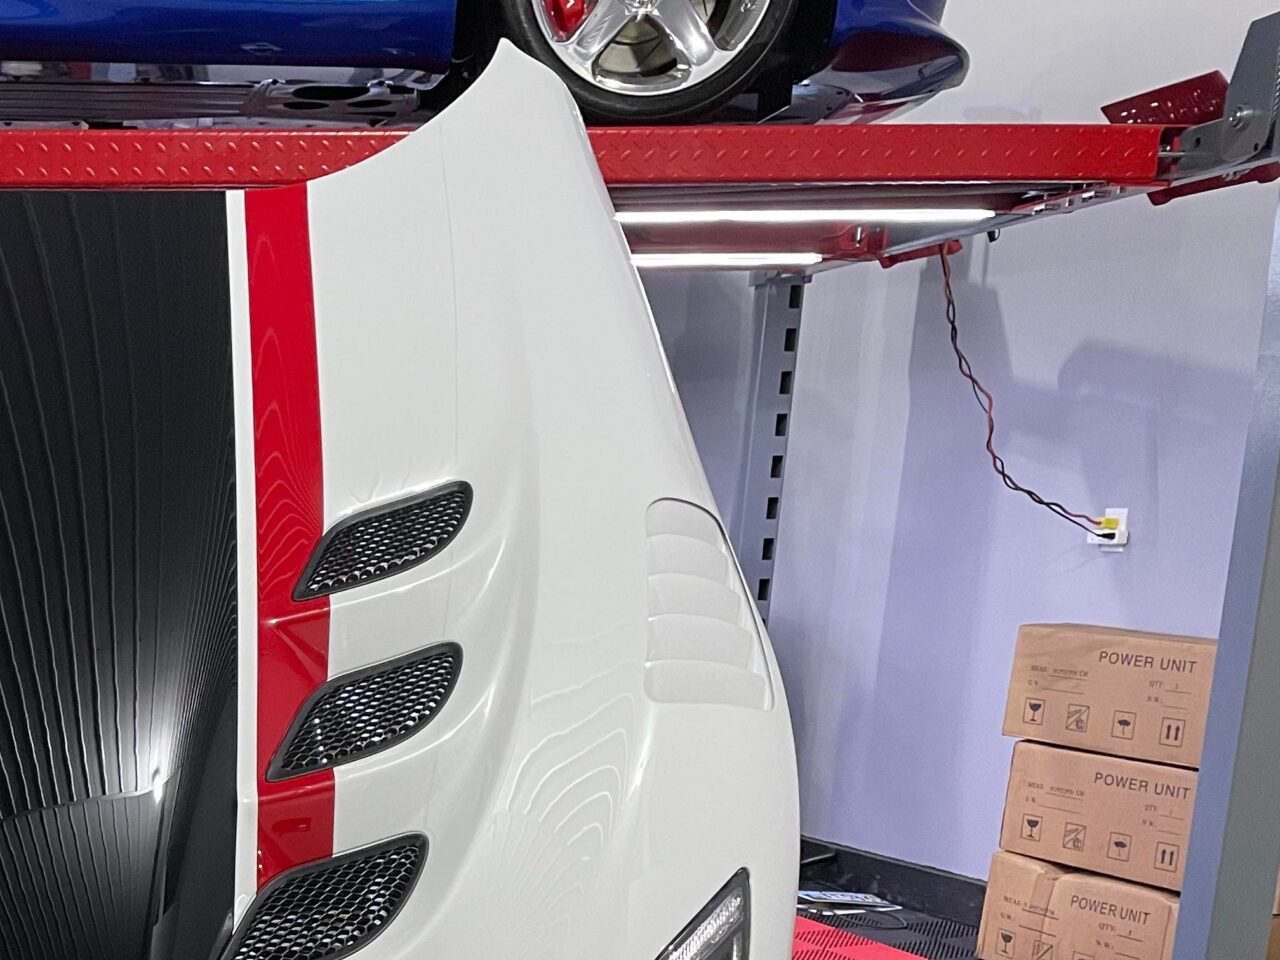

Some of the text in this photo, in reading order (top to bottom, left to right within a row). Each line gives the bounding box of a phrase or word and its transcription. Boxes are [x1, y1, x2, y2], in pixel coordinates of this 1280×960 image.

[1098, 650, 1198, 674] POWER UNIT
[1094, 772, 1149, 793] POWER
[1154, 782, 1192, 800] UNIT
[1070, 894, 1118, 918] POWER
[1120, 906, 1152, 925] UNIT
